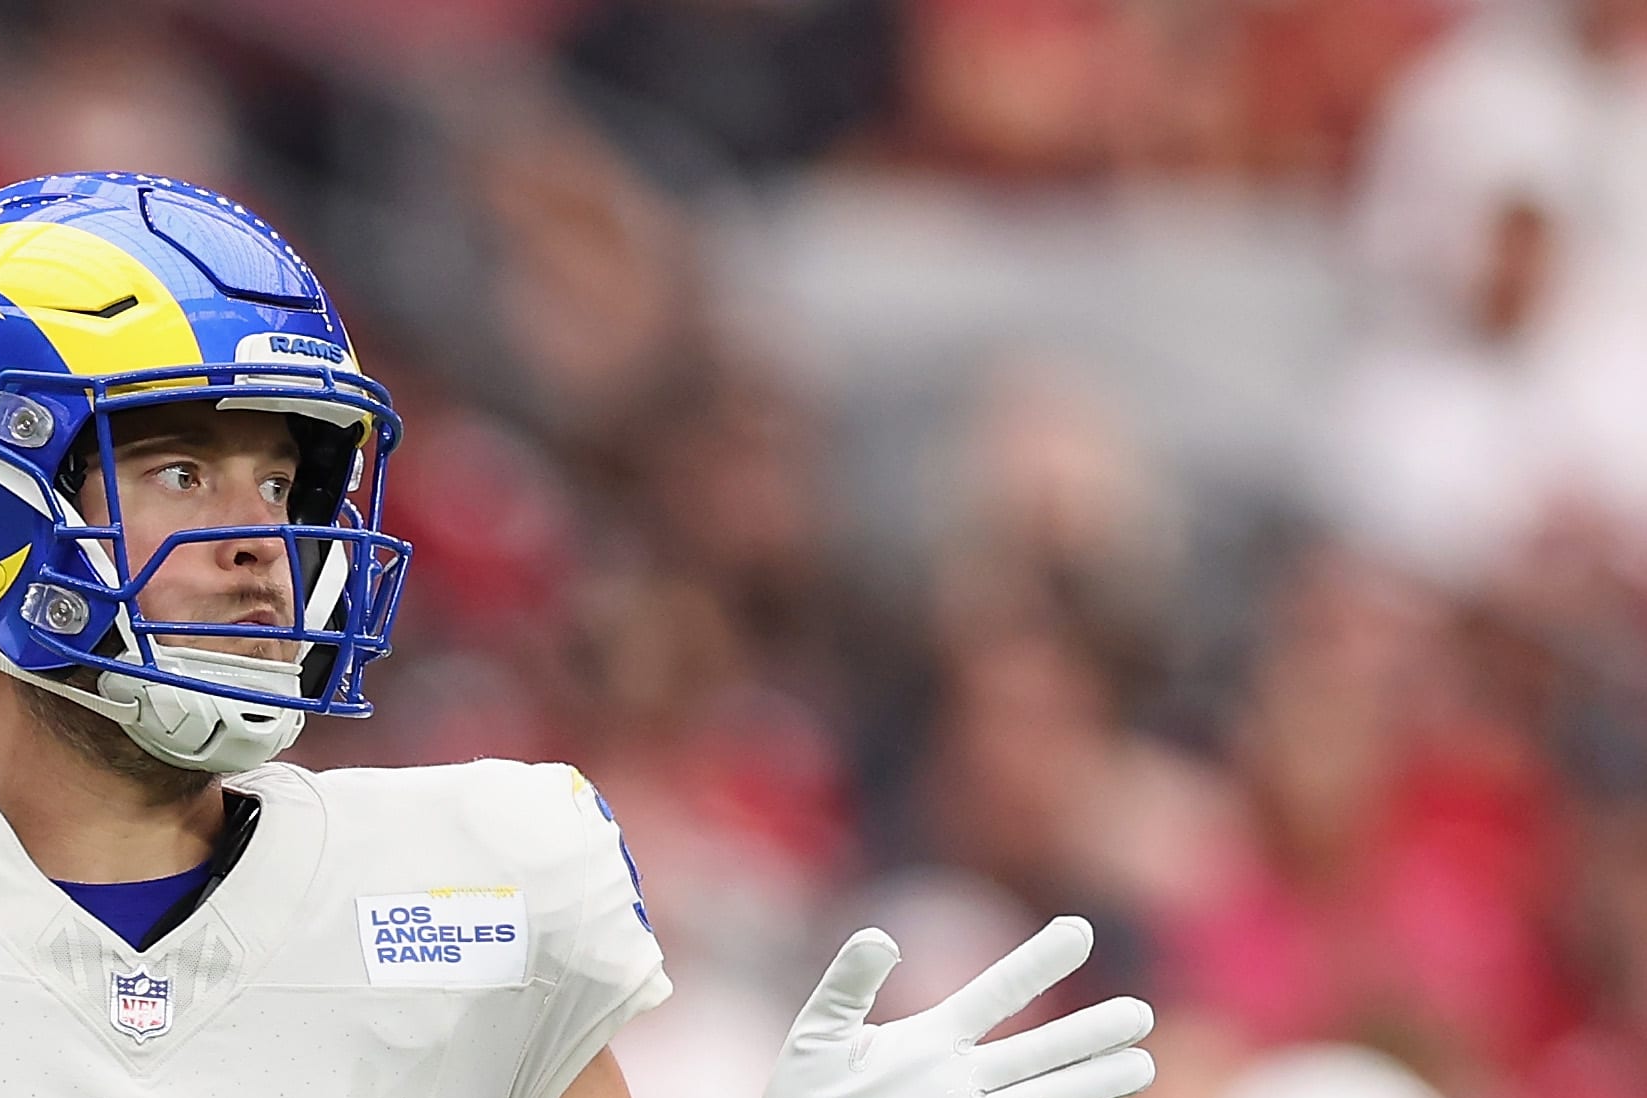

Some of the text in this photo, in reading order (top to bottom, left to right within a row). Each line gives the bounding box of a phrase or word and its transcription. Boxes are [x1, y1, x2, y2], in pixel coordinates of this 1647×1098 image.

[269, 336, 345, 364] RAMS
[371, 906, 432, 926] LOS
[374, 924, 516, 945] ANGELES
[377, 945, 462, 964] RAMS
